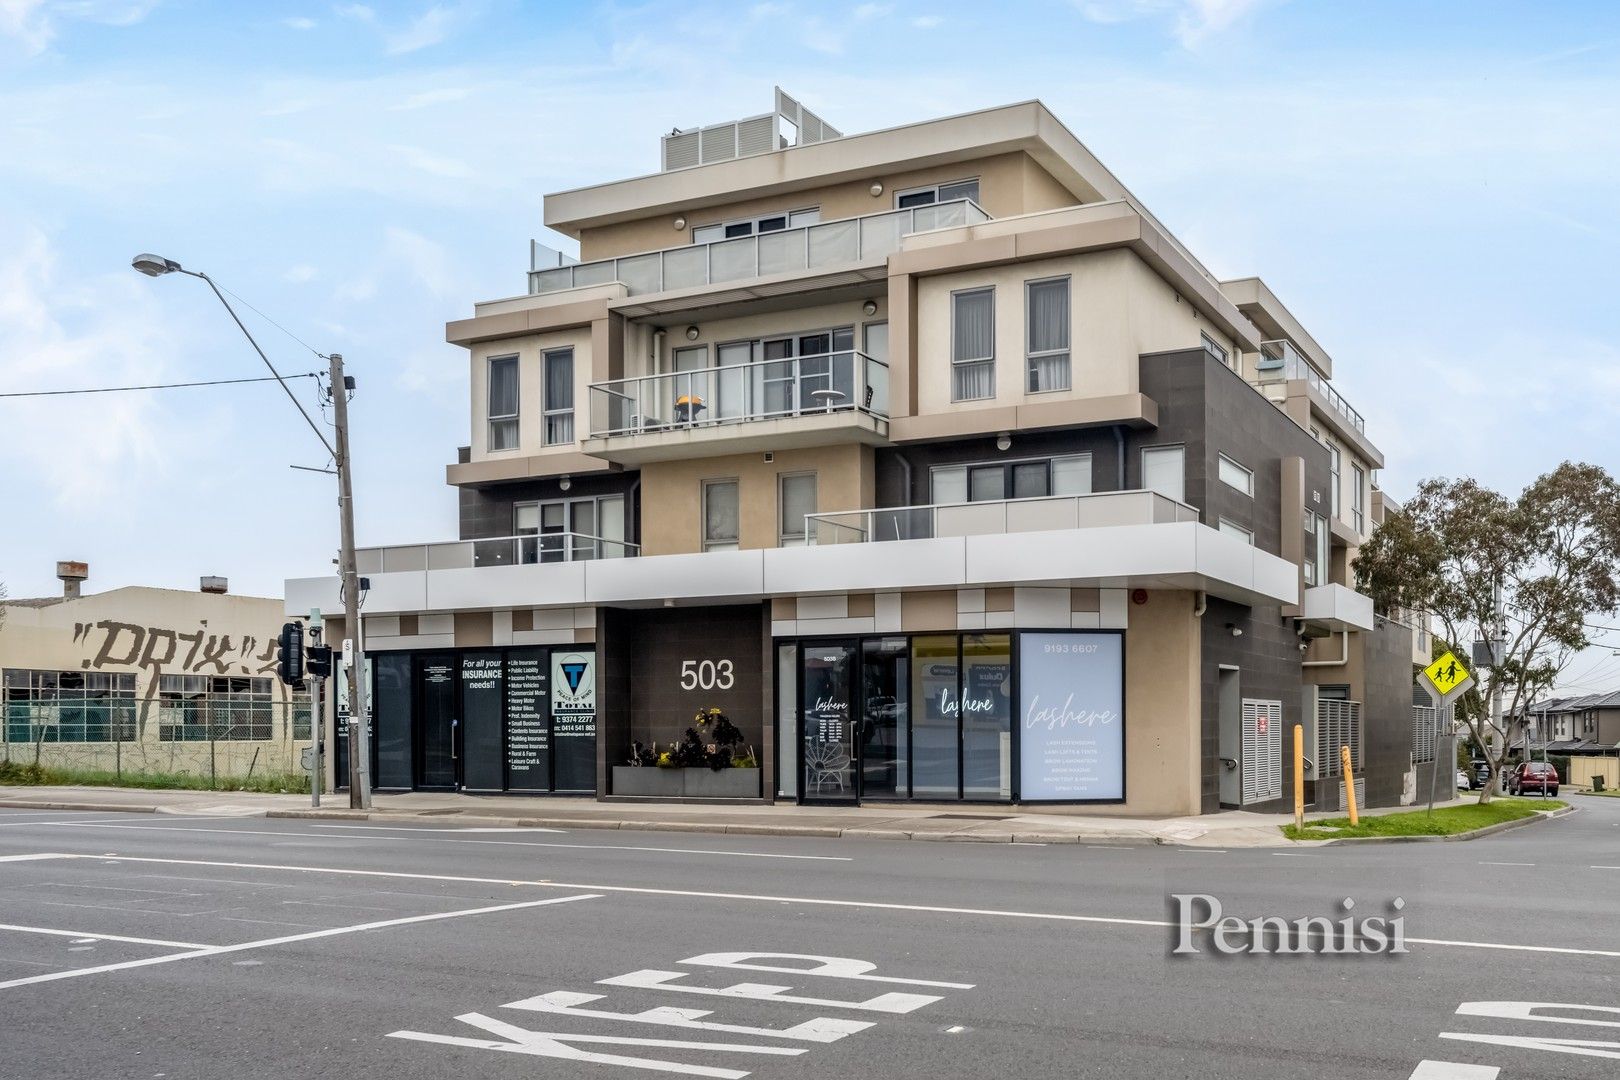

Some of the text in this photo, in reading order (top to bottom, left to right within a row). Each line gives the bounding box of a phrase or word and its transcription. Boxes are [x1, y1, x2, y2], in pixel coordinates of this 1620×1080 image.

[1044, 644, 1098, 653] 9193 6607
[462, 660, 502, 668] For all your
[462, 670, 502, 679] INSURANCE
[680, 659, 734, 690] 503
[564, 665, 584, 688] T
[1025, 693, 1118, 730] lashere
[384, 952, 977, 1080] KEEP
